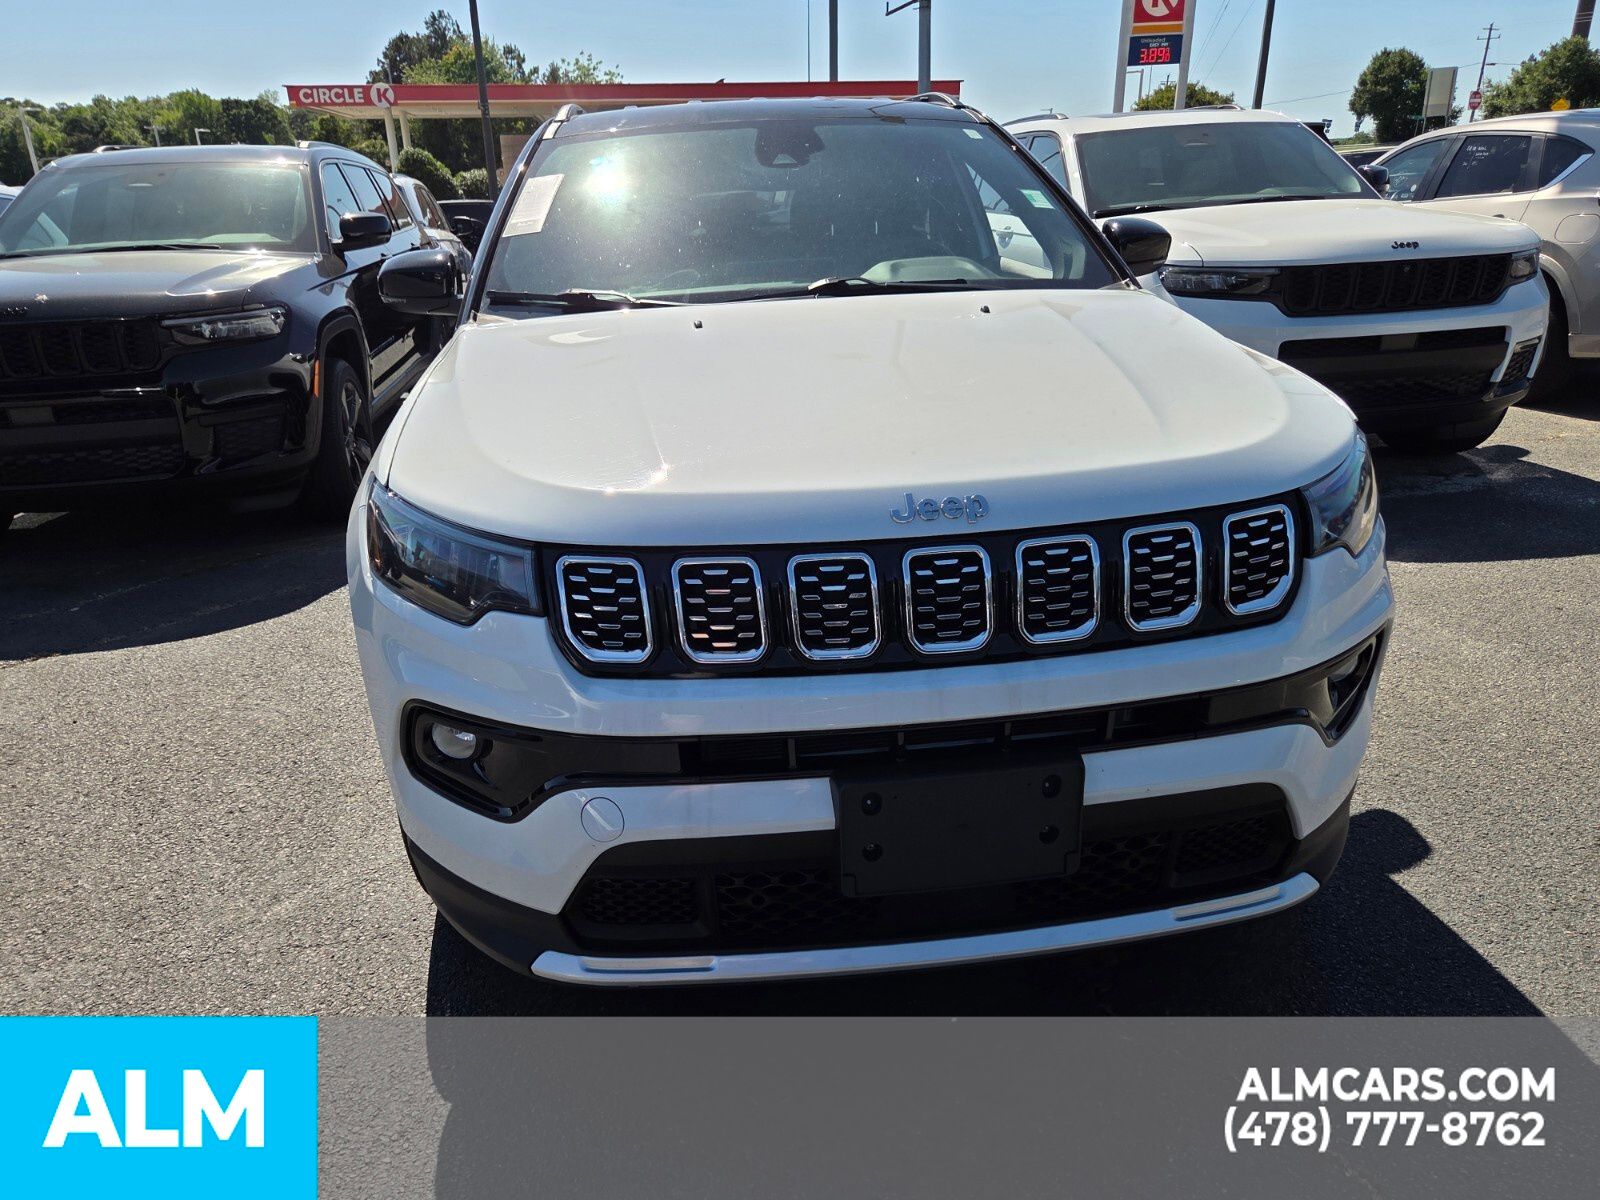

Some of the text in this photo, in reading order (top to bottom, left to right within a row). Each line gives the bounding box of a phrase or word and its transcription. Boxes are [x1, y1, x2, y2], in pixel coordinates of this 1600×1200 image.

[299, 86, 393, 106] CIRCLE K
[1391, 241, 1419, 249] Jeep
[890, 493, 990, 524] Jeep
